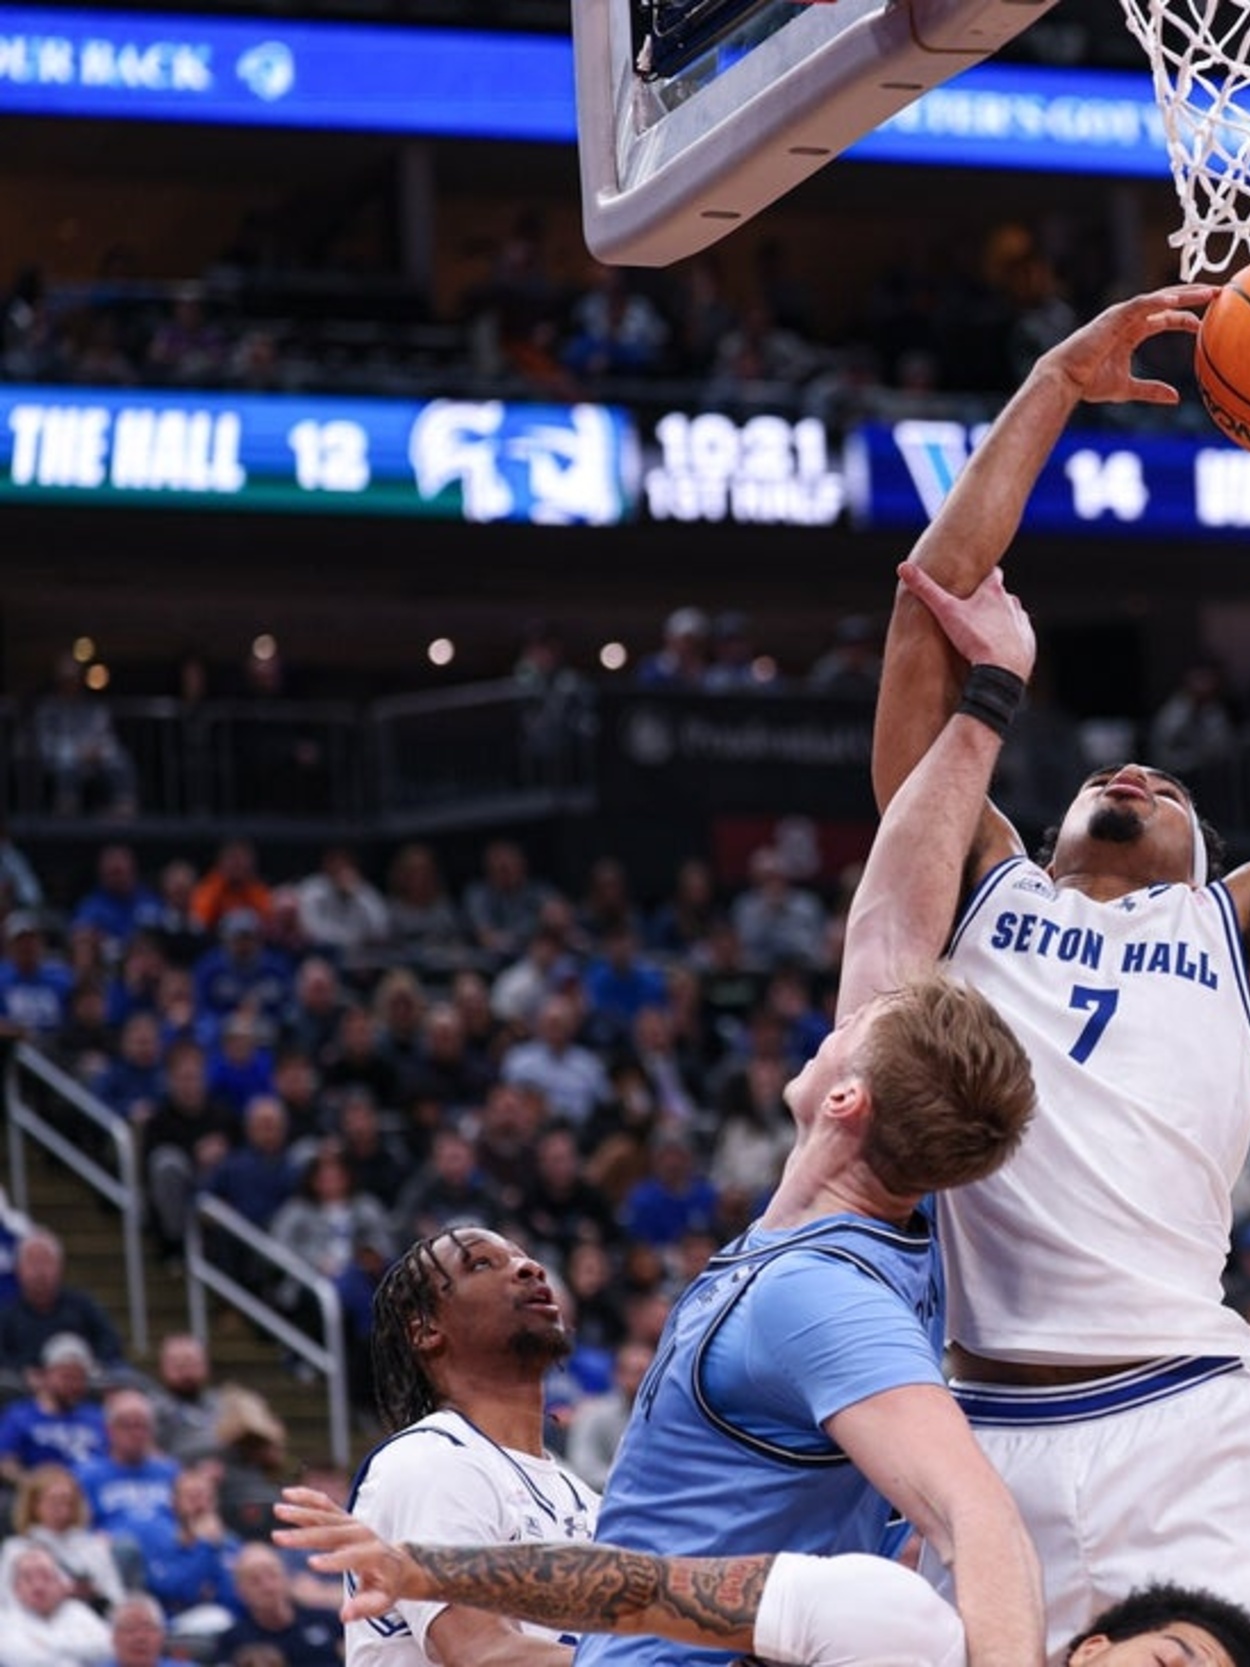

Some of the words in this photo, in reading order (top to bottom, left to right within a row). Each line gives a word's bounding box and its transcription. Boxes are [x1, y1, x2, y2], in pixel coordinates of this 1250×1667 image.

[80, 37, 213, 91] BACK
[8, 404, 111, 487] THE
[111, 407, 247, 493] HALL
[1065, 449, 1149, 521] 14
[990, 911, 1104, 971] SETON
[1121, 940, 1219, 991] HALL
[1068, 984, 1120, 1065] 7
